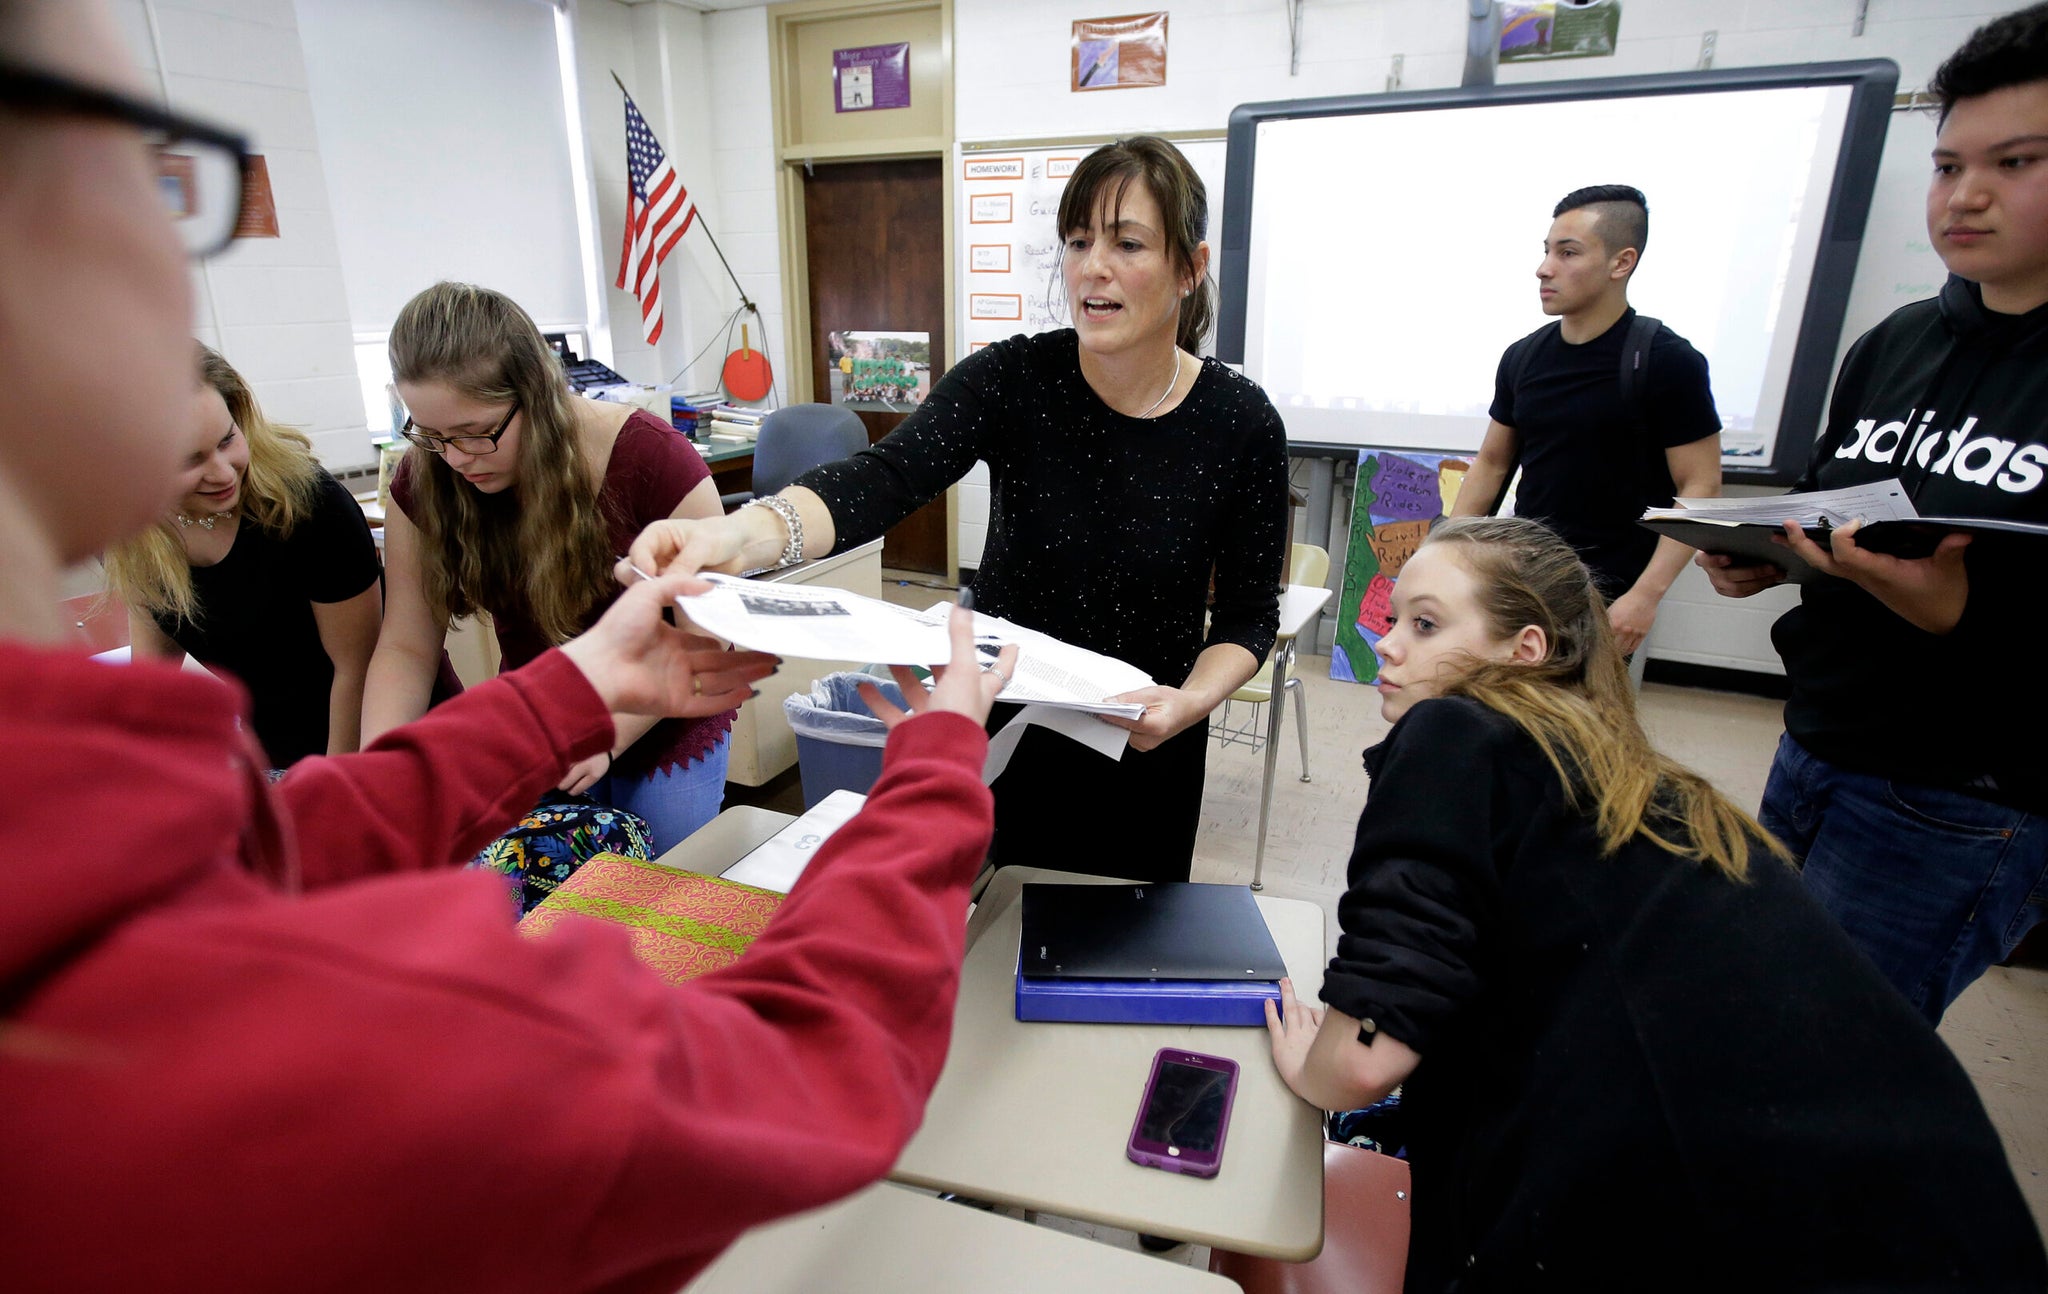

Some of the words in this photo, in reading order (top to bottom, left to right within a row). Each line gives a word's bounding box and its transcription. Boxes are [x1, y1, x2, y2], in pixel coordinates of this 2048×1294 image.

[970, 164, 1017, 174] HOMEWORK
[1834, 408, 2048, 493] adidas
[1385, 458, 1431, 483] Violent
[1379, 474, 1432, 497] Freedom
[1380, 490, 1422, 512] Rides
[1379, 523, 1421, 543] Civil
